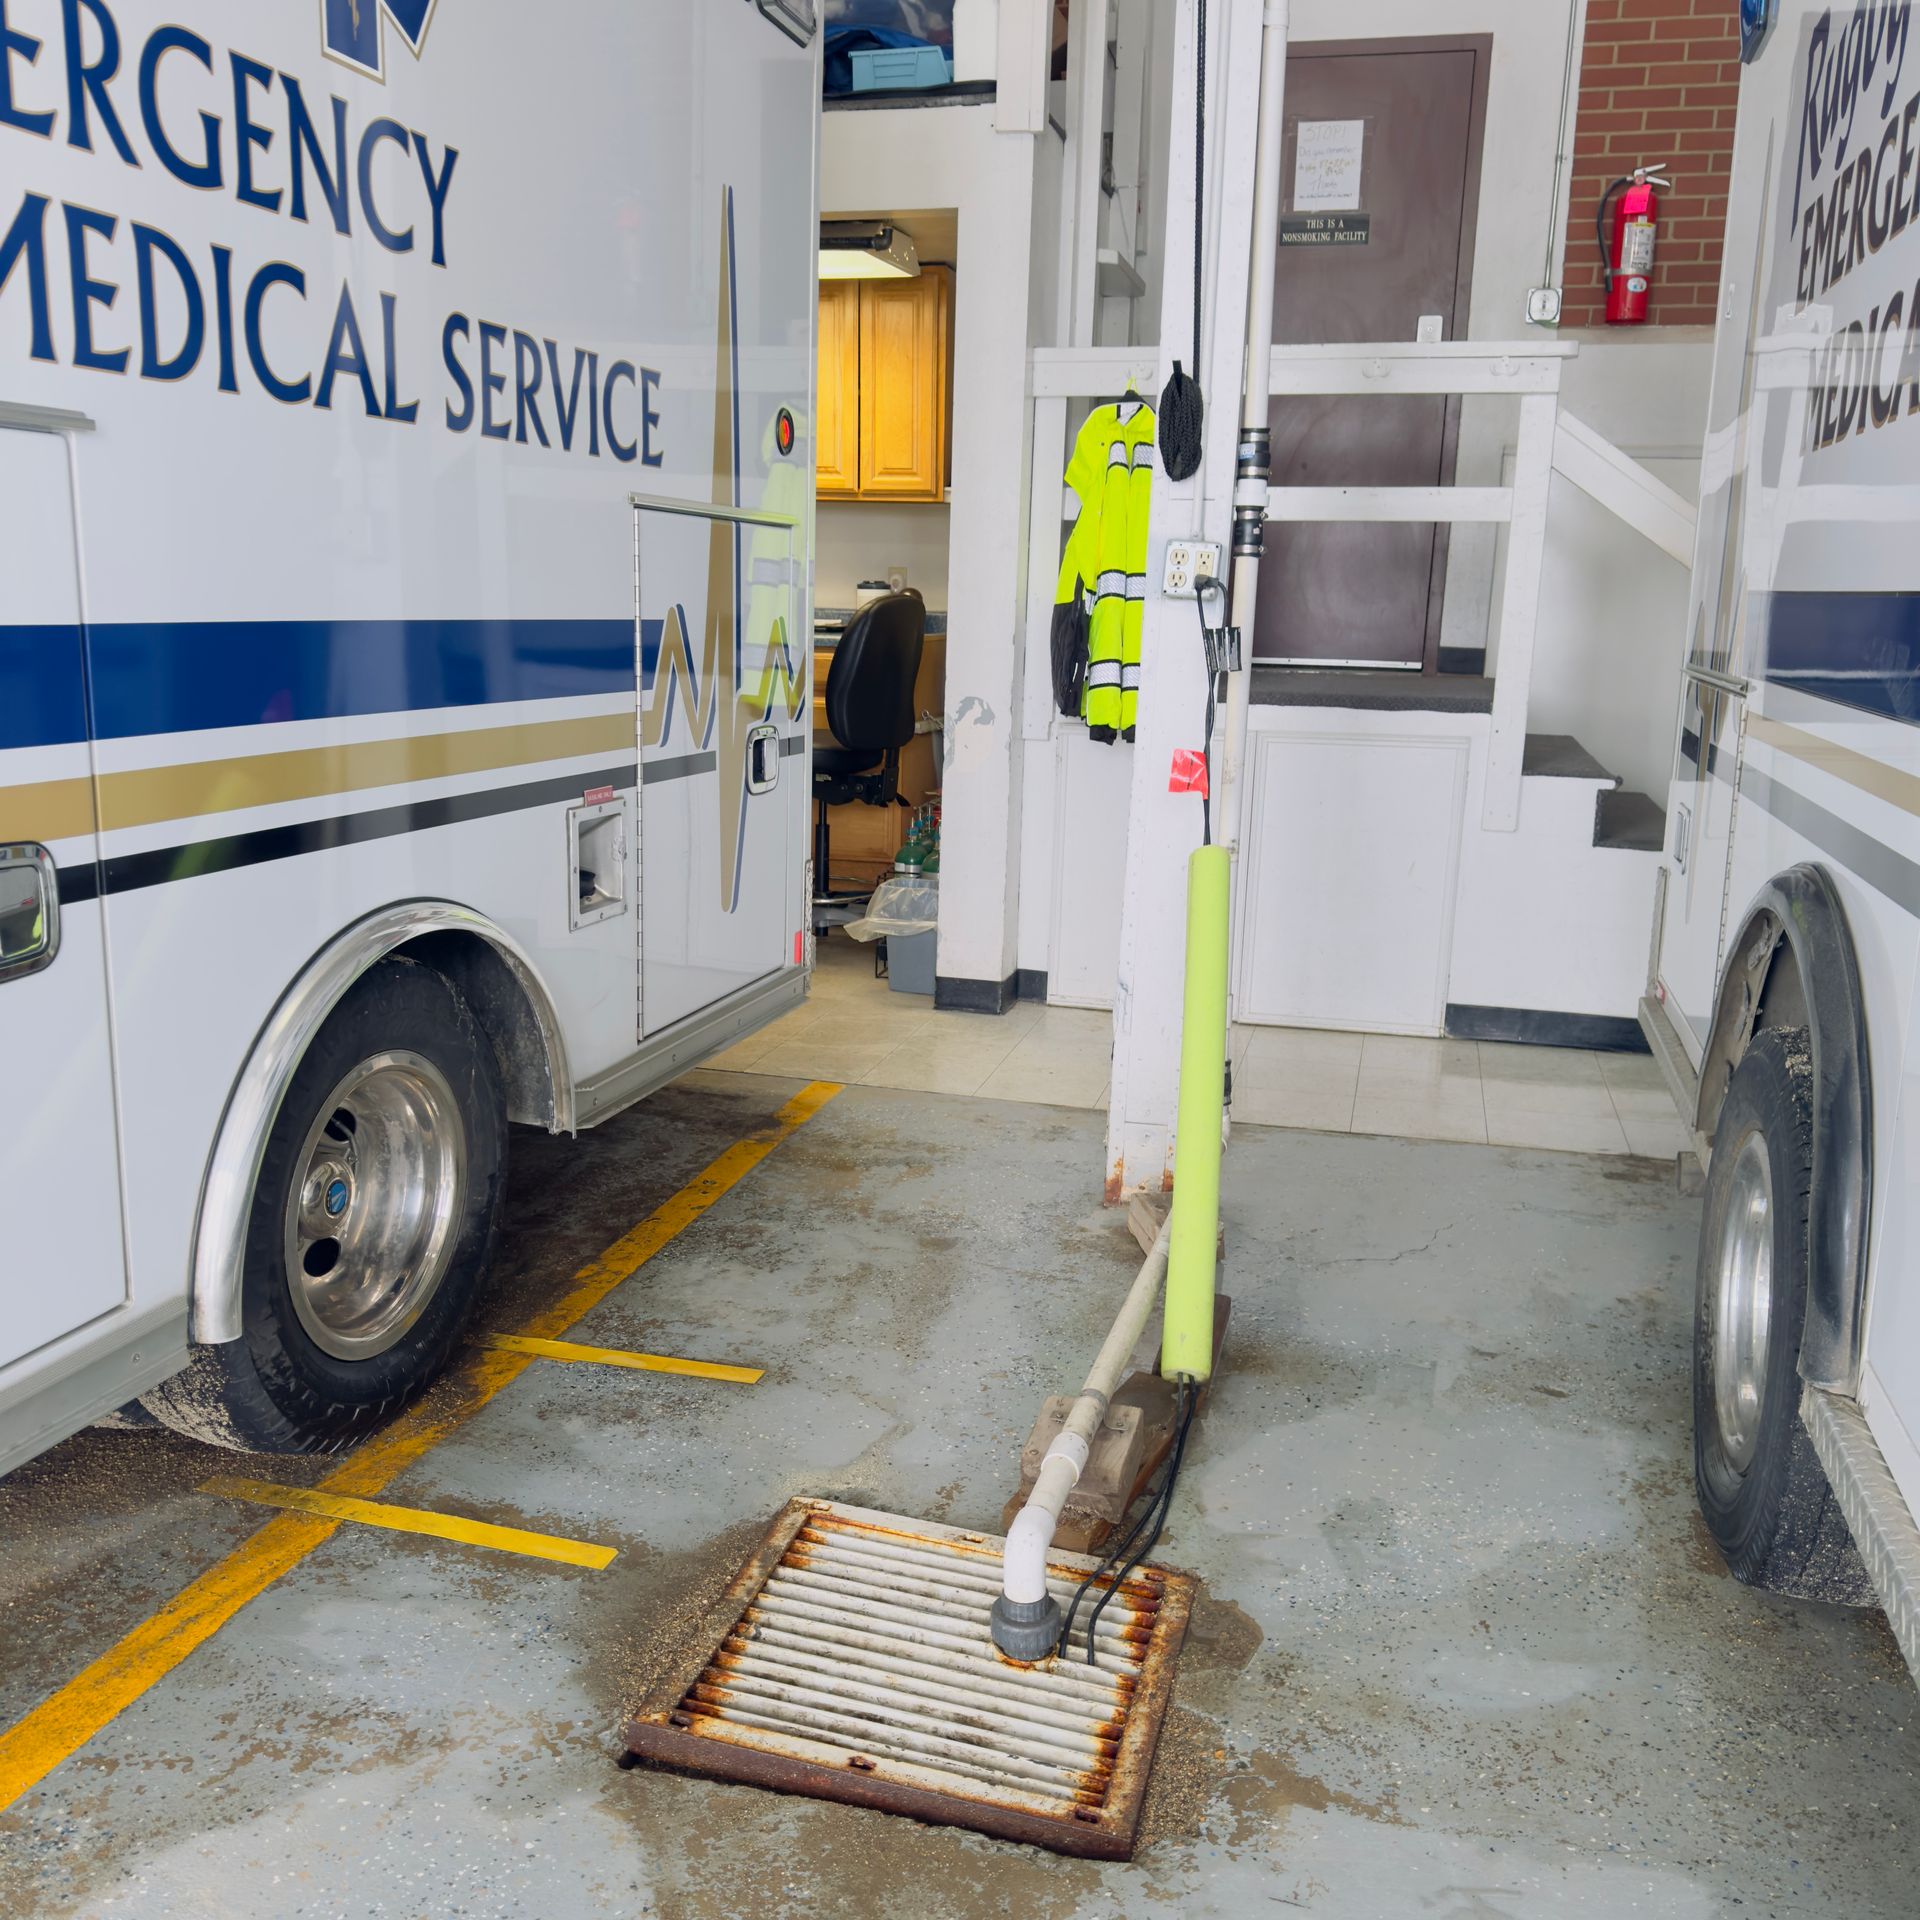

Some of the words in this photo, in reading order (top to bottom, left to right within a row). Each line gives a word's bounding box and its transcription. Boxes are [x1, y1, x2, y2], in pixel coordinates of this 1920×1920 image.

[1282, 232, 1331, 242] NONSMOKING
[1334, 231, 1367, 241] FACILITY
[1306, 219, 1324, 229] THIS
[1327, 218, 1336, 229] IS
[1338, 218, 1344, 228] A
[1795, 91, 1920, 316] EMERGE
[441, 311, 664, 468] SERVICE
